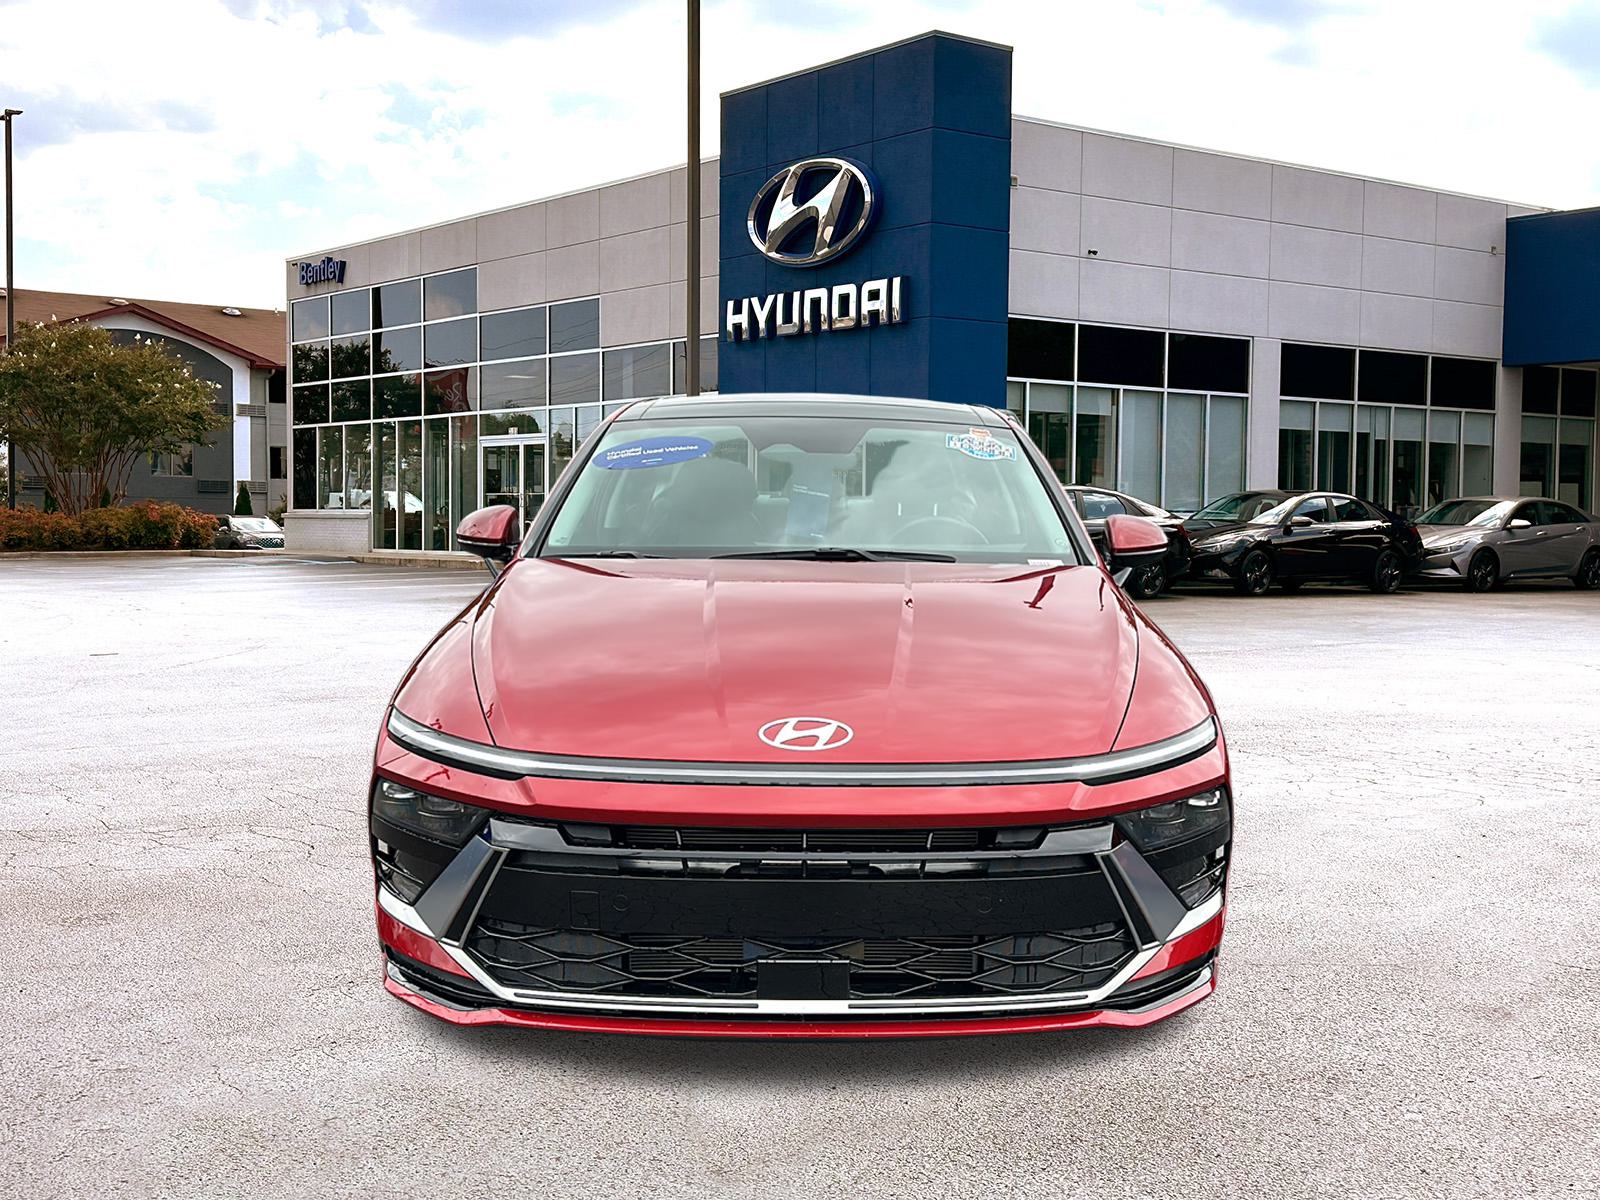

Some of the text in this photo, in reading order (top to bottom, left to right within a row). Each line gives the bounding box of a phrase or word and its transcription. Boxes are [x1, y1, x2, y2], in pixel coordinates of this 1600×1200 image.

[298, 256, 347, 286] Bentley
[726, 276, 904, 342] HYUNDAI
[642, 447, 664, 455] Used
[664, 444, 699, 453] Vehicles
